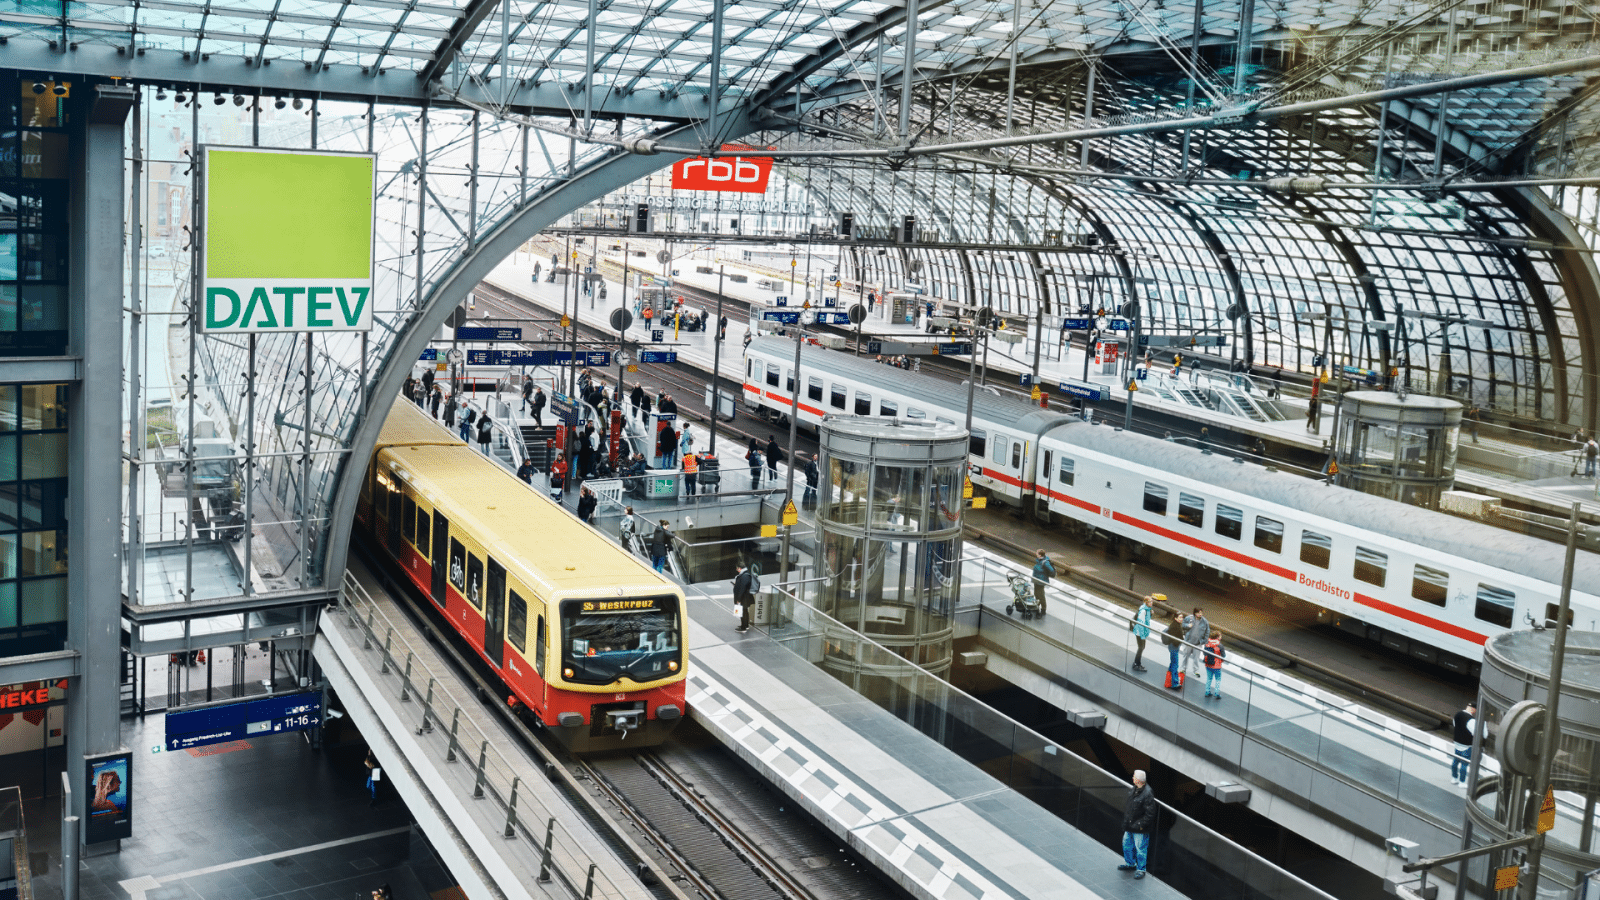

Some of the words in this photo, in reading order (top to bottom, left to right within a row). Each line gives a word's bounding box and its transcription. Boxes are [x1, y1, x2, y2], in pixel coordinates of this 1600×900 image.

[682, 156, 760, 183] rbb
[206, 287, 371, 329] DATEV
[653, 330, 664, 340] 15
[870, 343, 879, 352] 14
[1021, 373, 1028, 383] F
[1299, 573, 1350, 600] Bordbistro
[583, 601, 594, 611] S5
[600, 600, 654, 611] Westkreuz
[285, 714, 309, 729] 11-16
